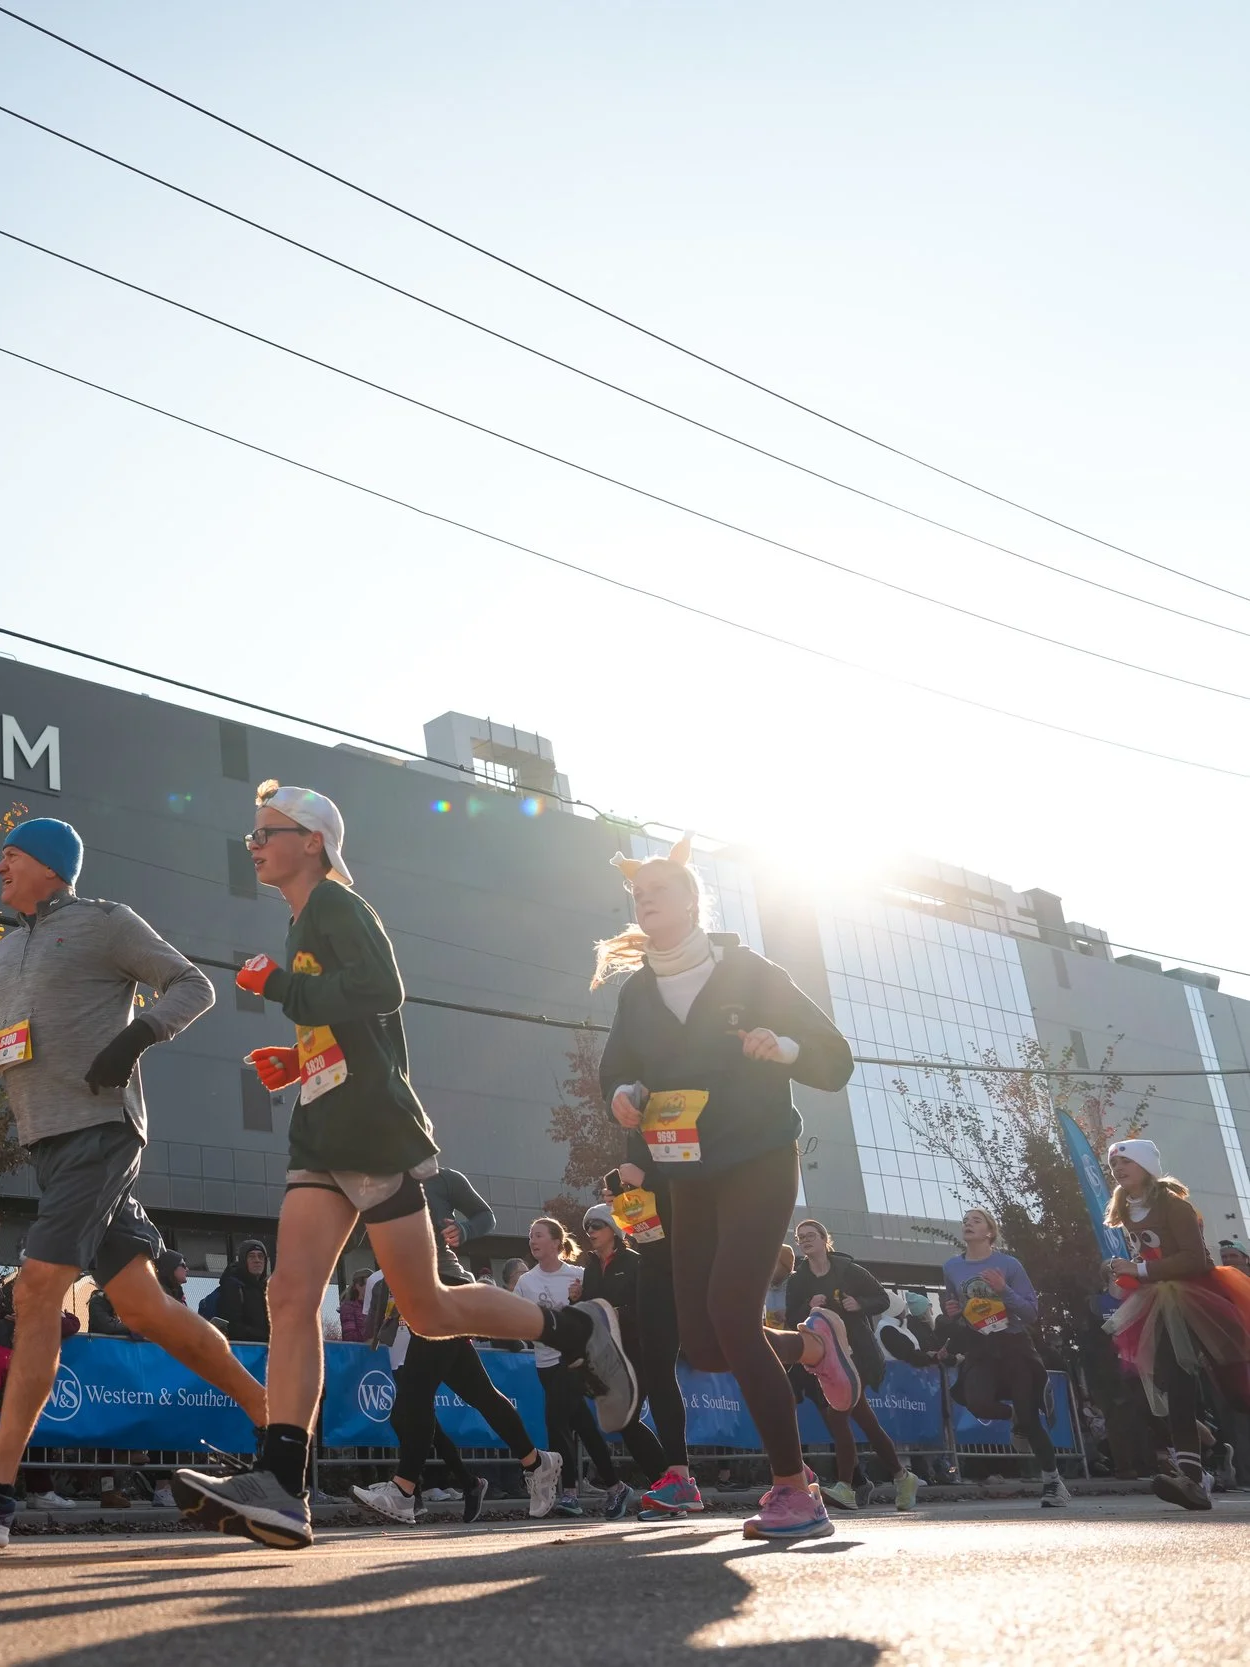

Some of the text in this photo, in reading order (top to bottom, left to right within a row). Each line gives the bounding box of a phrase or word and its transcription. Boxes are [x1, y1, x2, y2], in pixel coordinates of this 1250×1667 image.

[305, 1054, 326, 1075] 3820
[656, 1131, 677, 1143] 9693
[85, 1384, 154, 1405] Western
[158, 1387, 173, 1406] &
[360, 1384, 394, 1411] W&S
[690, 1393, 699, 1408] &
